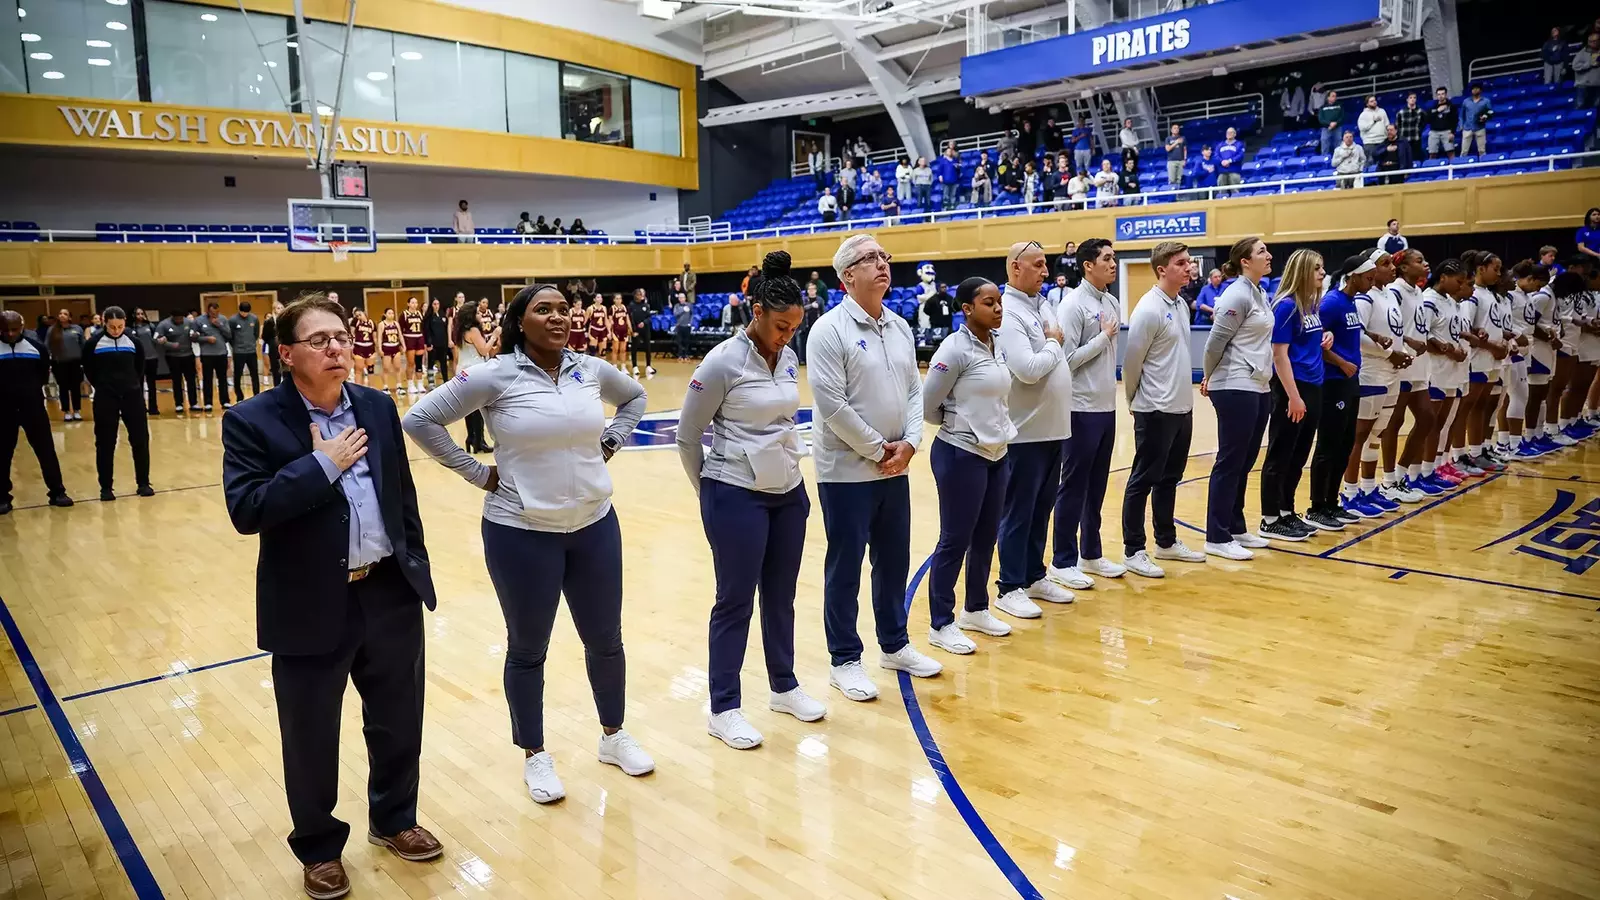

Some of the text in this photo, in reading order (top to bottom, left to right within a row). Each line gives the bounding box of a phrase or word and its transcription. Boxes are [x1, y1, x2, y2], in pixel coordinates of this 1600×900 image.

[1091, 18, 1191, 66] PIRATES
[58, 105, 429, 158] WALSH GYMNASIUM
[1135, 216, 1201, 230] PIRATE
[1134, 227, 1201, 235] BASKETBALL
[409, 322, 421, 333] 41
